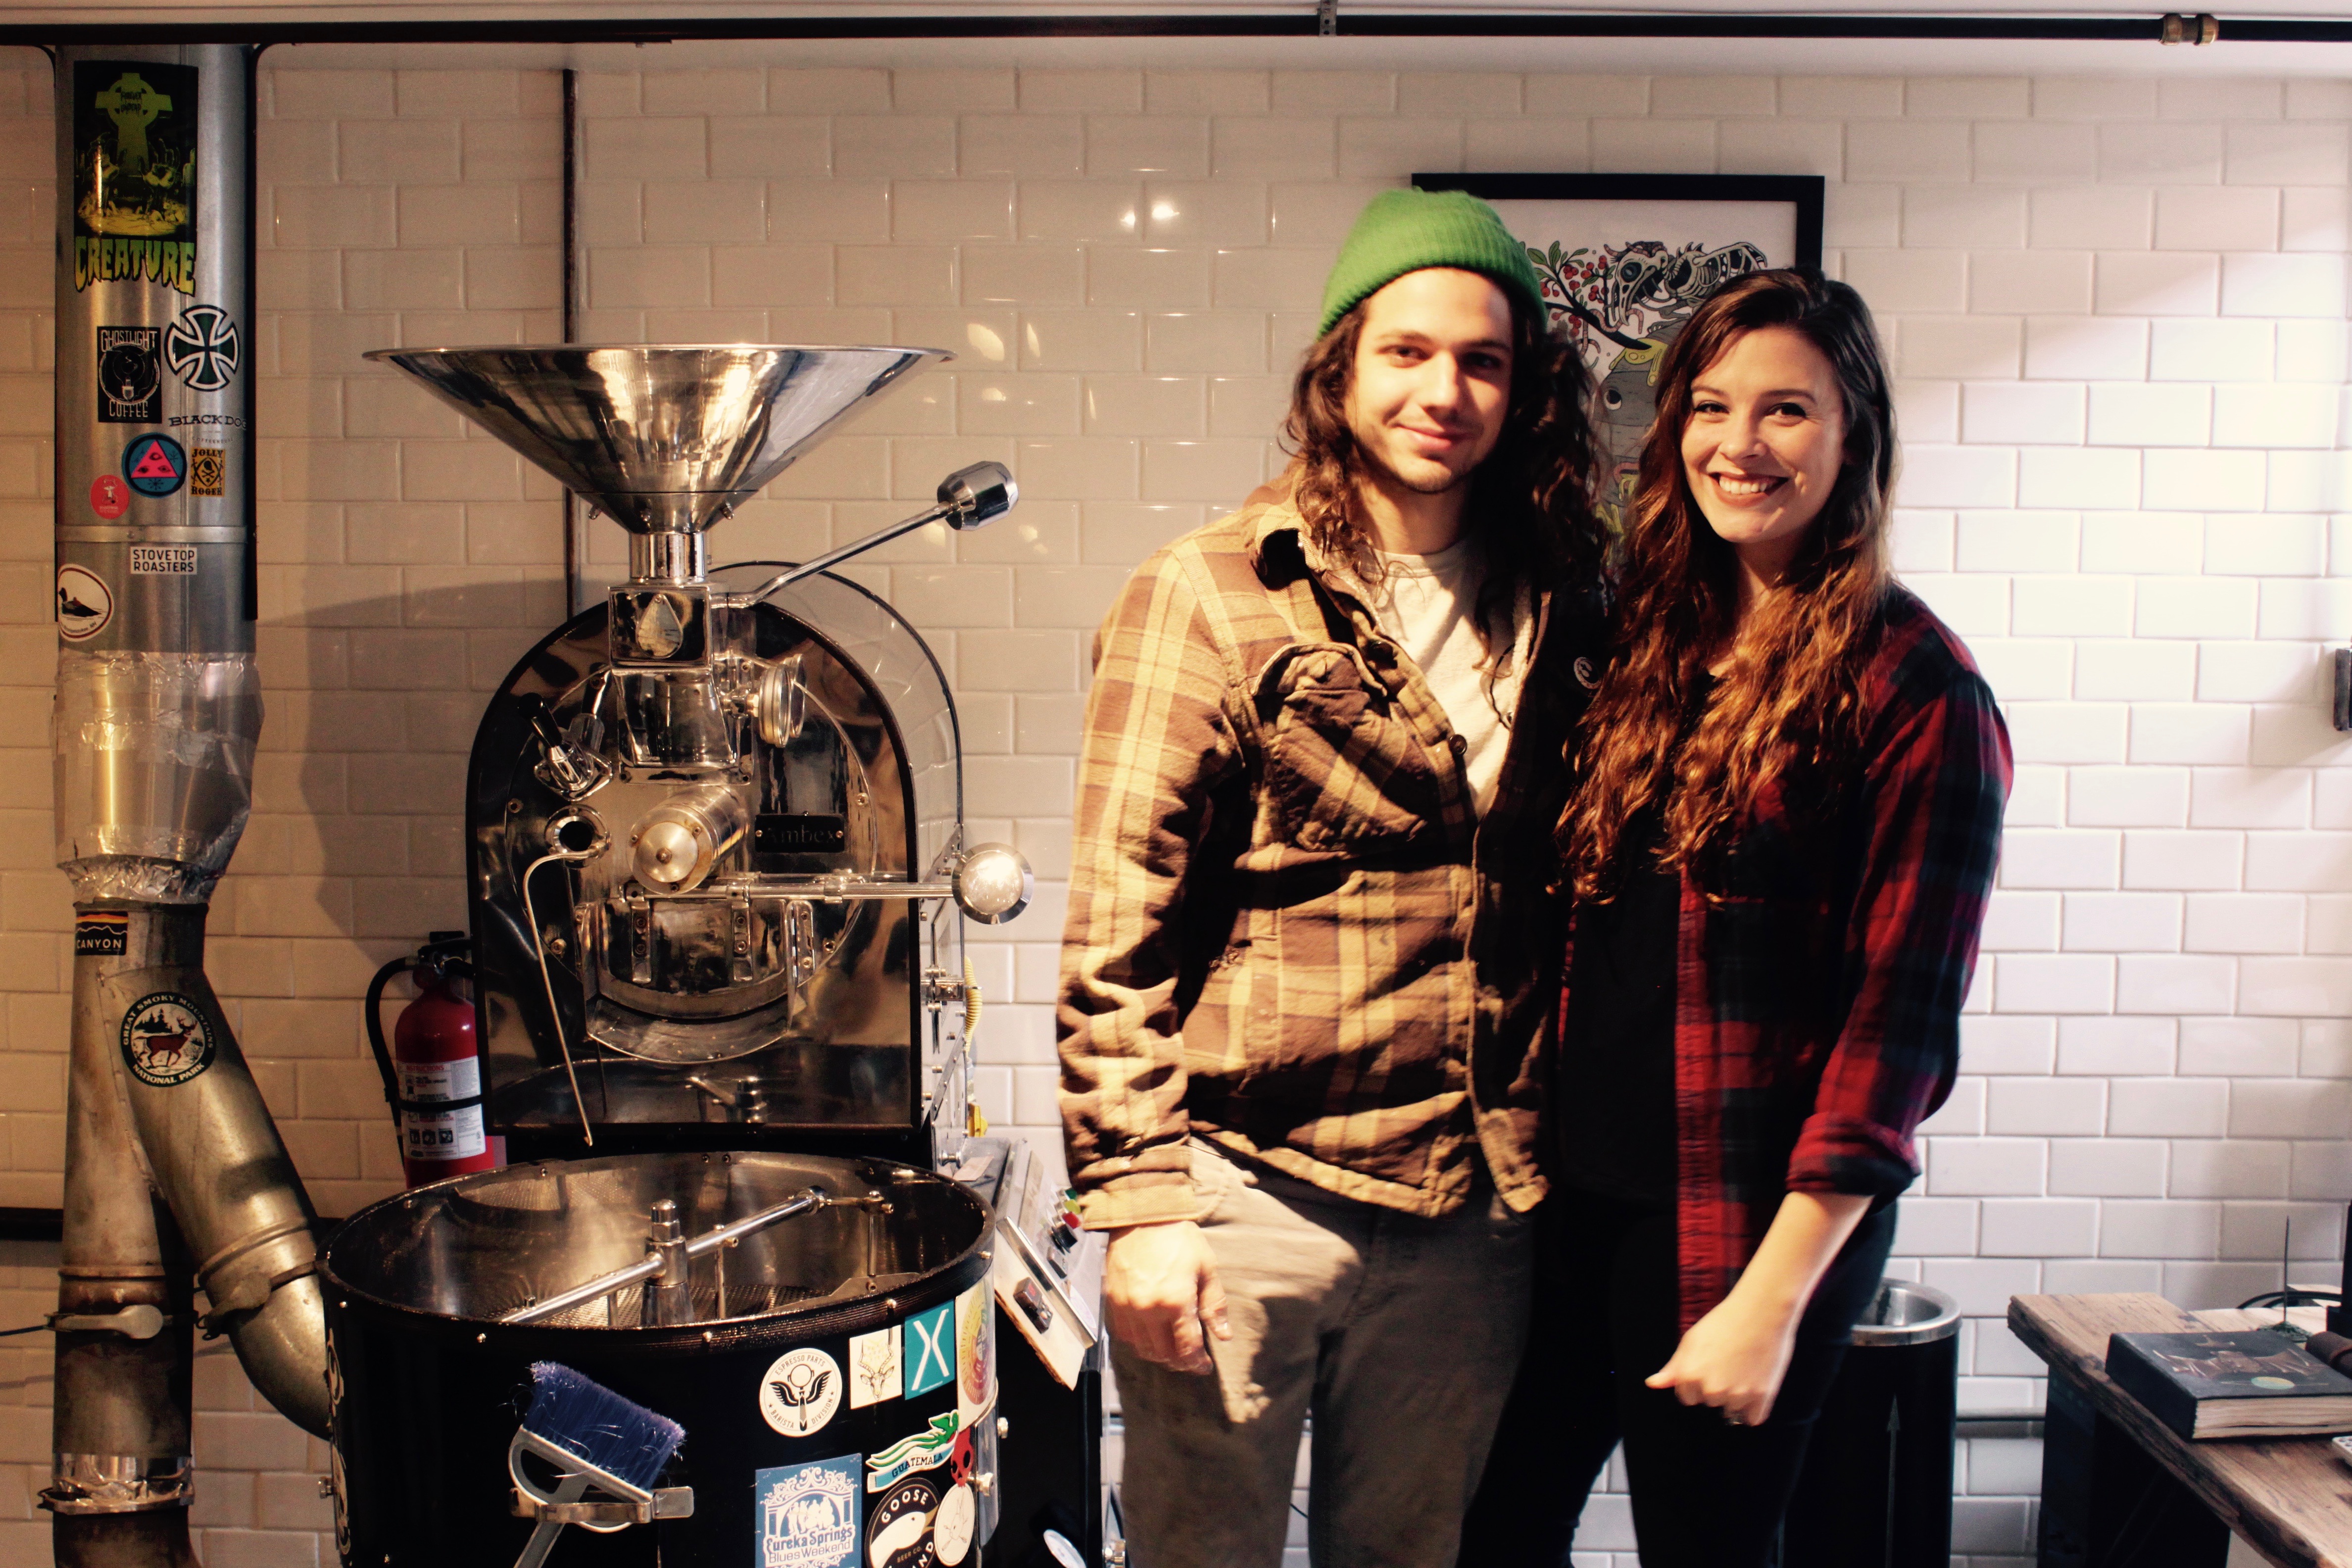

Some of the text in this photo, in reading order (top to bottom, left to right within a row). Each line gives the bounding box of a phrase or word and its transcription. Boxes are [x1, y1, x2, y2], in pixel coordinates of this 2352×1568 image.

[75, 236, 196, 296] CREATURE
[100, 329, 157, 352] GHOSTLIGHT
[109, 399, 148, 417] COFFEE
[169, 415, 222, 426] BLACK
[192, 449, 223, 457] JOLLY
[191, 486, 222, 495] ROGER
[133, 549, 195, 560] STOVETOP
[134, 561, 194, 572] ROASTERS
[77, 939, 122, 949] CANYON
[123, 995, 213, 1048] GREAT SMOKY MOUNTAINS
[132, 1062, 204, 1084] NATIONAL PARK
[775, 1355, 826, 1375] ESPRESSO PARTS
[771, 1398, 833, 1428] BARISTA DIVISION
[892, 1453, 943, 1477] GUATEMALA
[881, 1489, 929, 1523] GOOSE
[767, 1527, 853, 1552] Eureka Springs
[769, 1540, 850, 1563] Blues Weekend
[897, 1553, 912, 1563] BEER
